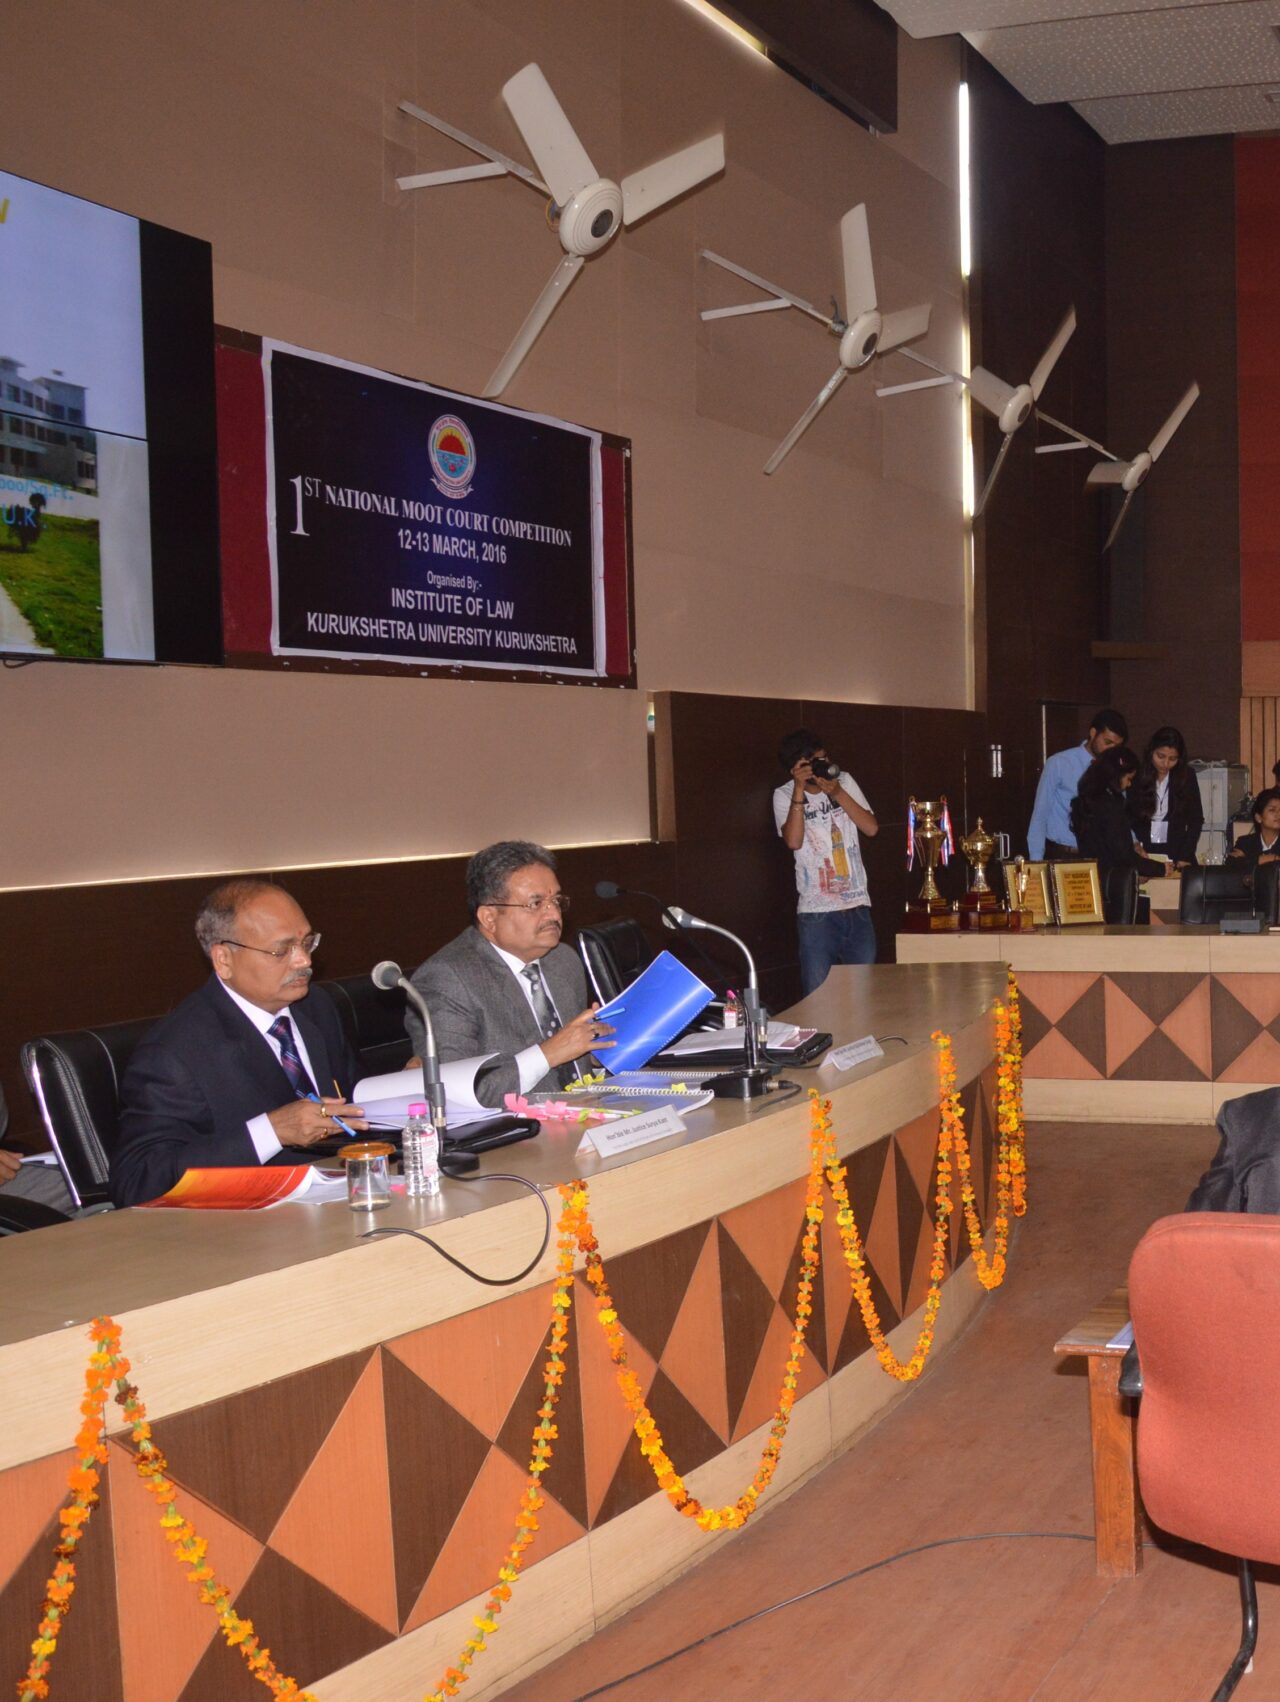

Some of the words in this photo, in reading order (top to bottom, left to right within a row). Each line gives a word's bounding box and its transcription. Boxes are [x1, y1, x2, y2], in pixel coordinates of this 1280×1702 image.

[325, 484, 399, 517] NATIONAL
[402, 499, 444, 525] MOOT
[446, 507, 490, 533] COURT
[492, 516, 572, 547] COMPETITION
[398, 528, 430, 553] 12-13
[432, 533, 479, 563] MARCH,
[482, 542, 508, 564] 2016
[427, 570, 466, 590] Organised
[391, 587, 463, 615] INSTITUTE
[465, 596, 484, 617] OF
[487, 599, 515, 620] LAW
[307, 611, 416, 641] KURUKSHETRA
[418, 622, 493, 648] UNIVERSITY
[495, 630, 578, 655] KURUKSHETRA
